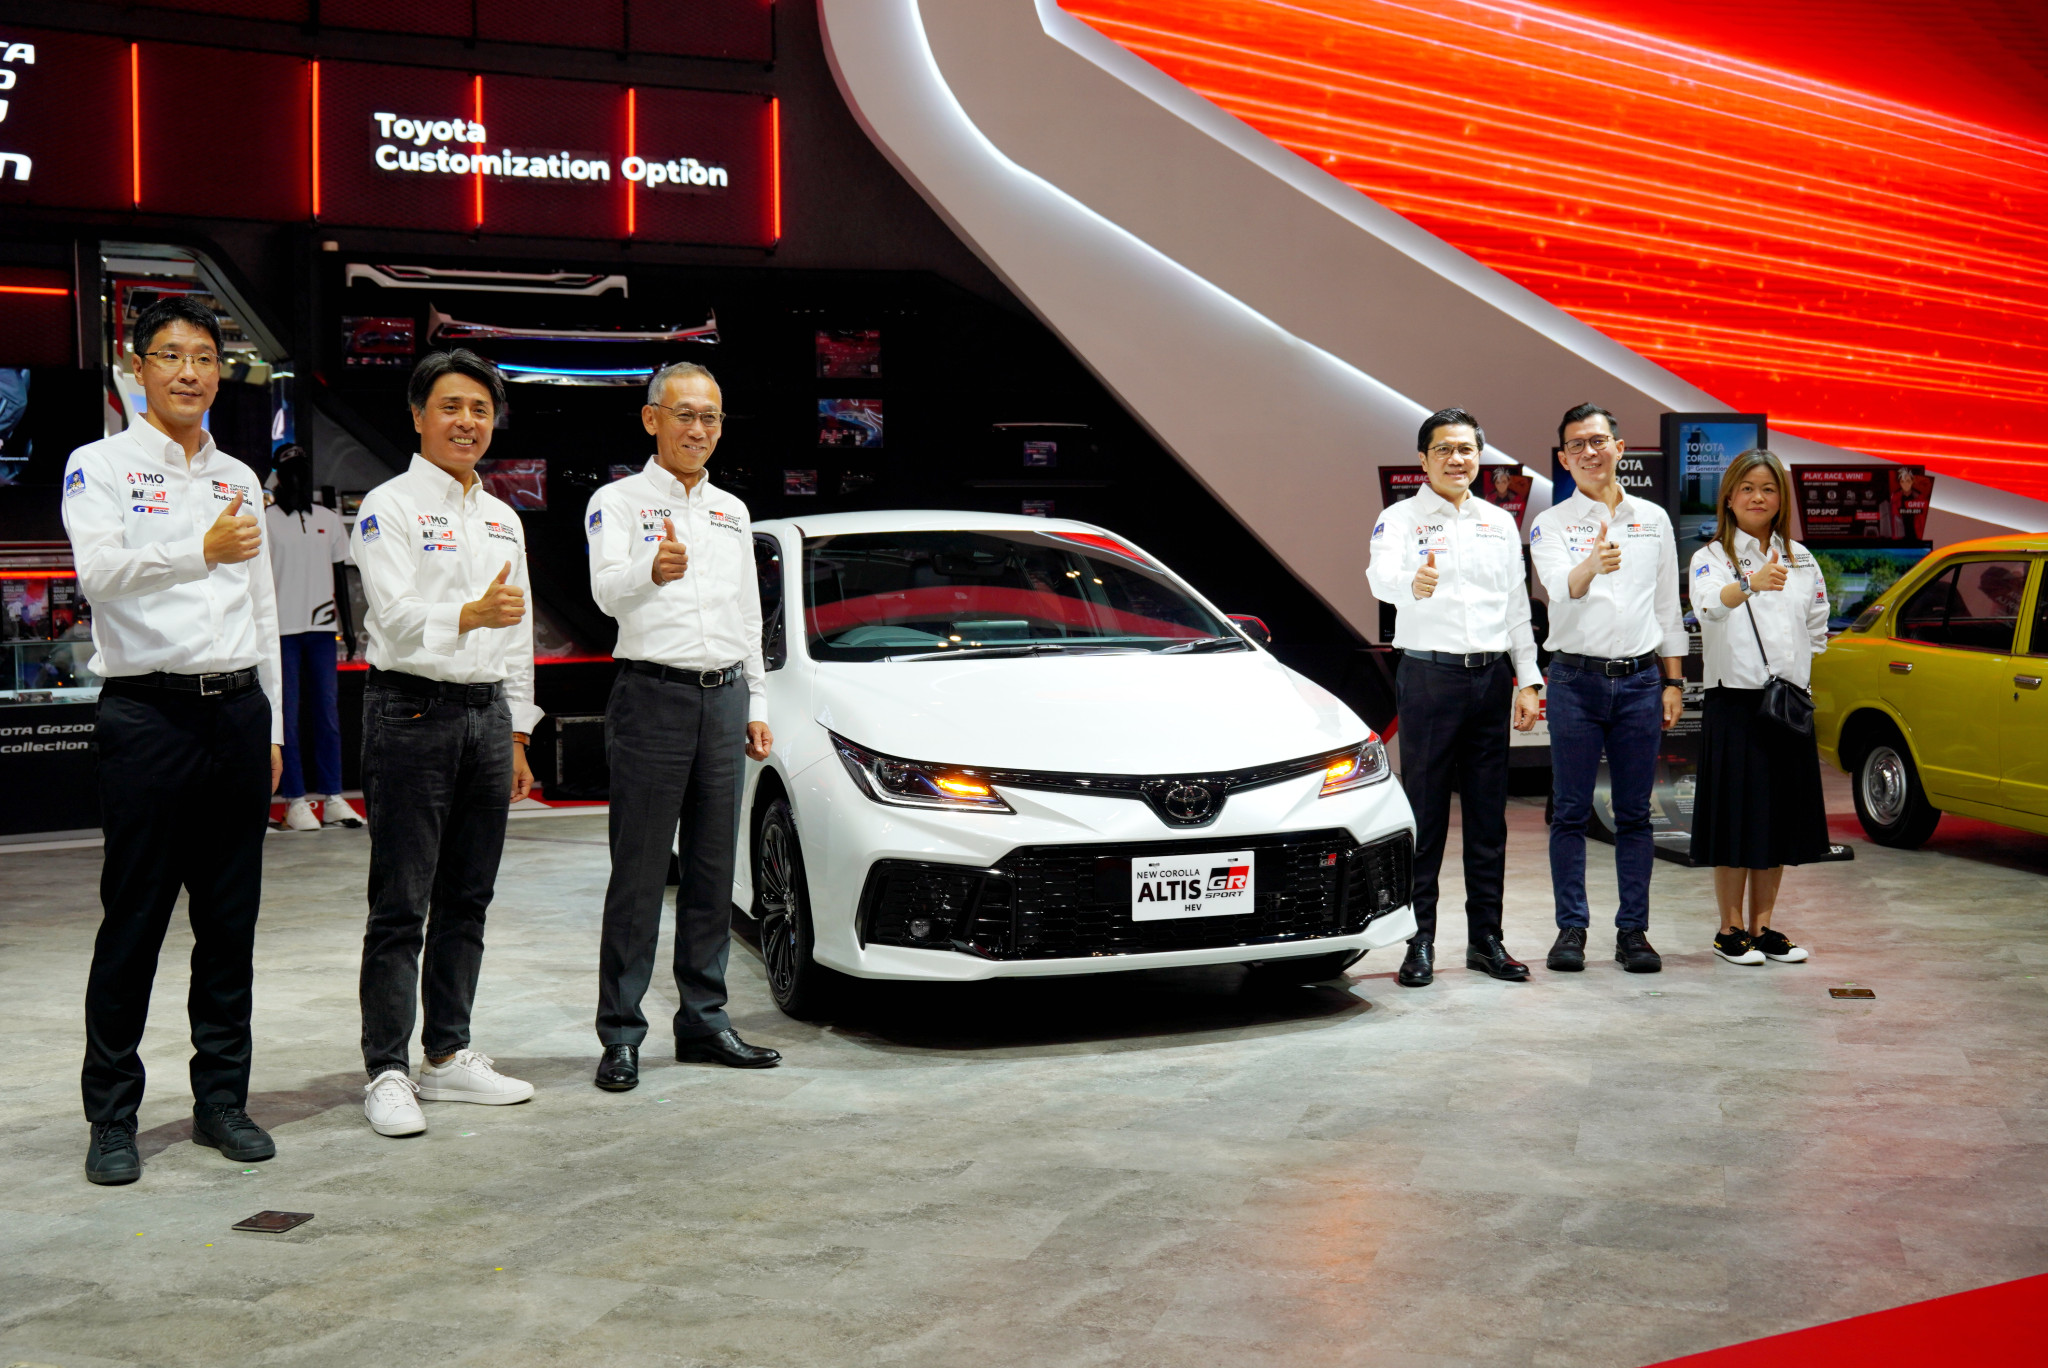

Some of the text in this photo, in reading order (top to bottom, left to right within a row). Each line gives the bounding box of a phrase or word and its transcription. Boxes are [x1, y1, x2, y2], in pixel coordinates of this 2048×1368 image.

[374, 112, 487, 146] Toyota
[375, 145, 729, 188] Customization Option
[1685, 442, 1725, 452] TOYOTA
[1685, 454, 1722, 463] COROLLA
[1616, 459, 1644, 471] OTA
[135, 472, 165, 484] TMO
[1392, 475, 1412, 483] PLAY,
[1804, 472, 1823, 480] PLAY,
[647, 509, 672, 518] TMO
[425, 515, 449, 525] TMO
[1424, 524, 1444, 533] TMO
[1572, 525, 1594, 533] TMO
[1735, 558, 1752, 567] MO
[1816, 591, 1825, 599] 3M
[0, 723, 95, 737] OTA GAZOO
[0, 741, 89, 753] collection
[1828, 845, 1845, 855] EP
[1319, 857, 1337, 867] GR
[1136, 868, 1200, 879] NEW COROLLA
[1207, 874, 1248, 891] GR
[1137, 879, 1202, 903] ALTIS
[1204, 890, 1244, 899] SPORT
[1184, 904, 1202, 912] HEV
